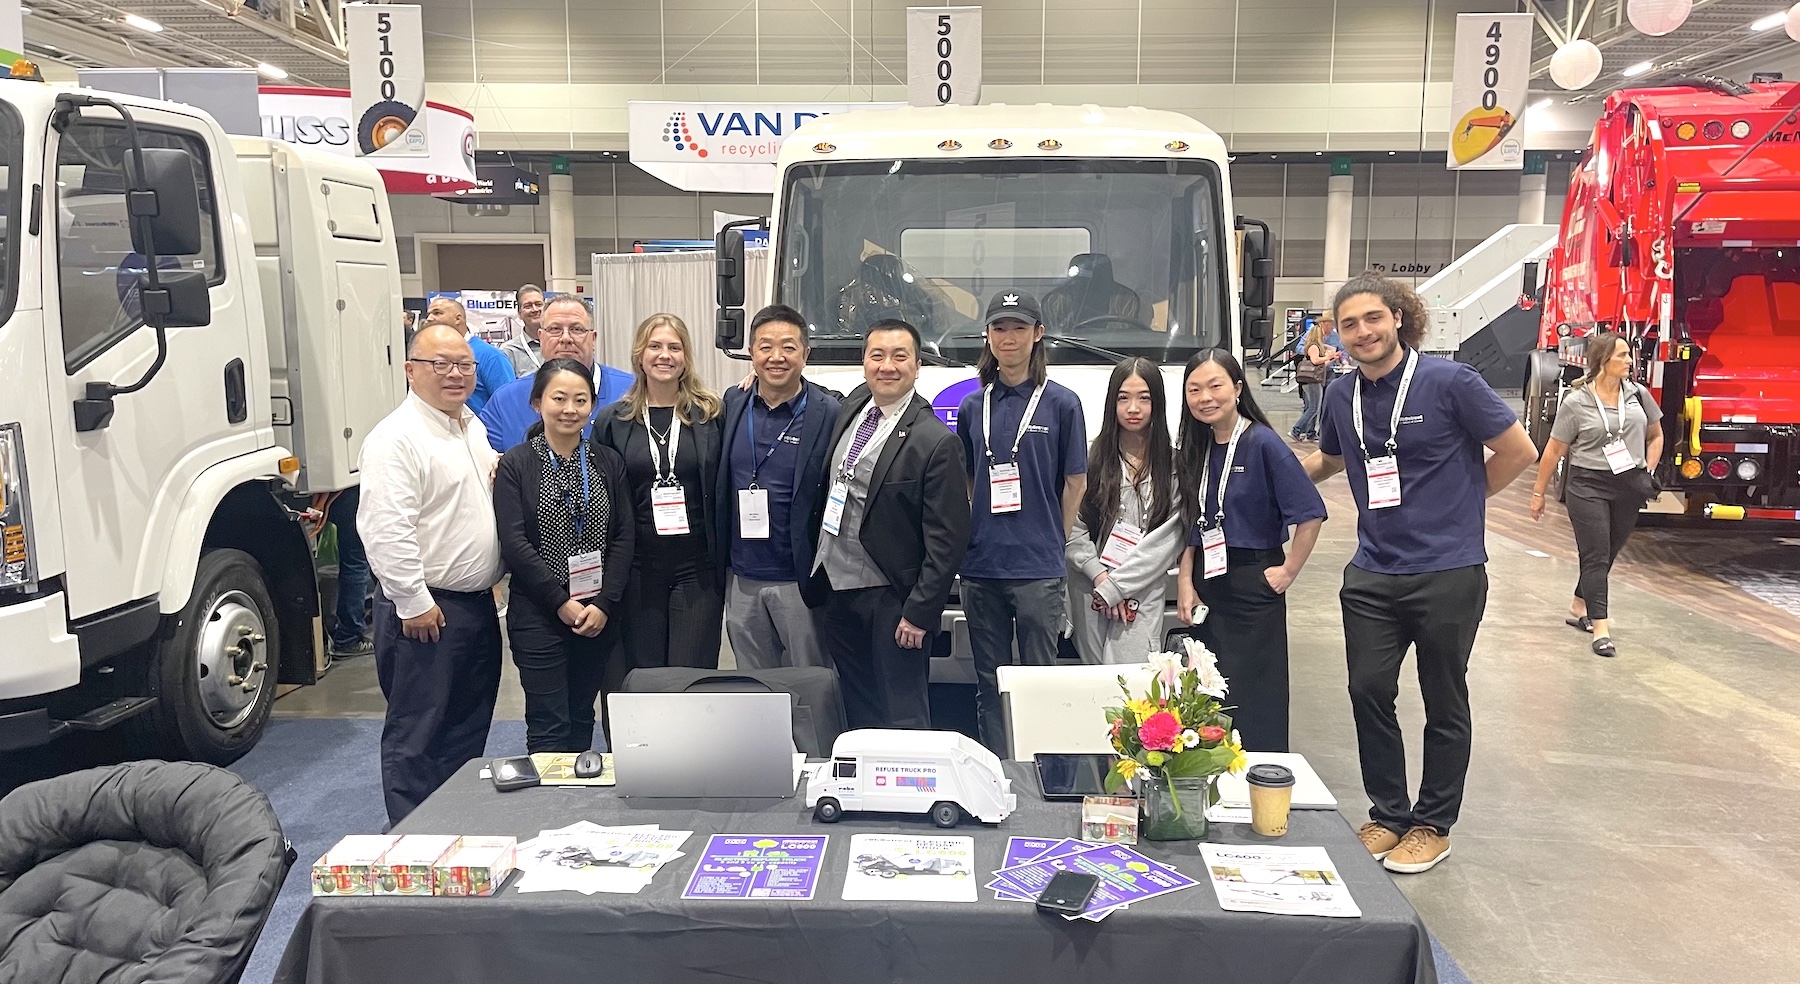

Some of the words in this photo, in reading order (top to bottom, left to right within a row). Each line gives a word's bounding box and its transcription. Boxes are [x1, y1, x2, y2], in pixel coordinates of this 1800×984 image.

[377, 12, 396, 101] 5100
[937, 14, 952, 104] 5000
[1482, 21, 1502, 111] 4900
[697, 112, 782, 136] VAN
[1391, 263, 1431, 274] Lobby
[1215, 852, 1261, 861] LC600
